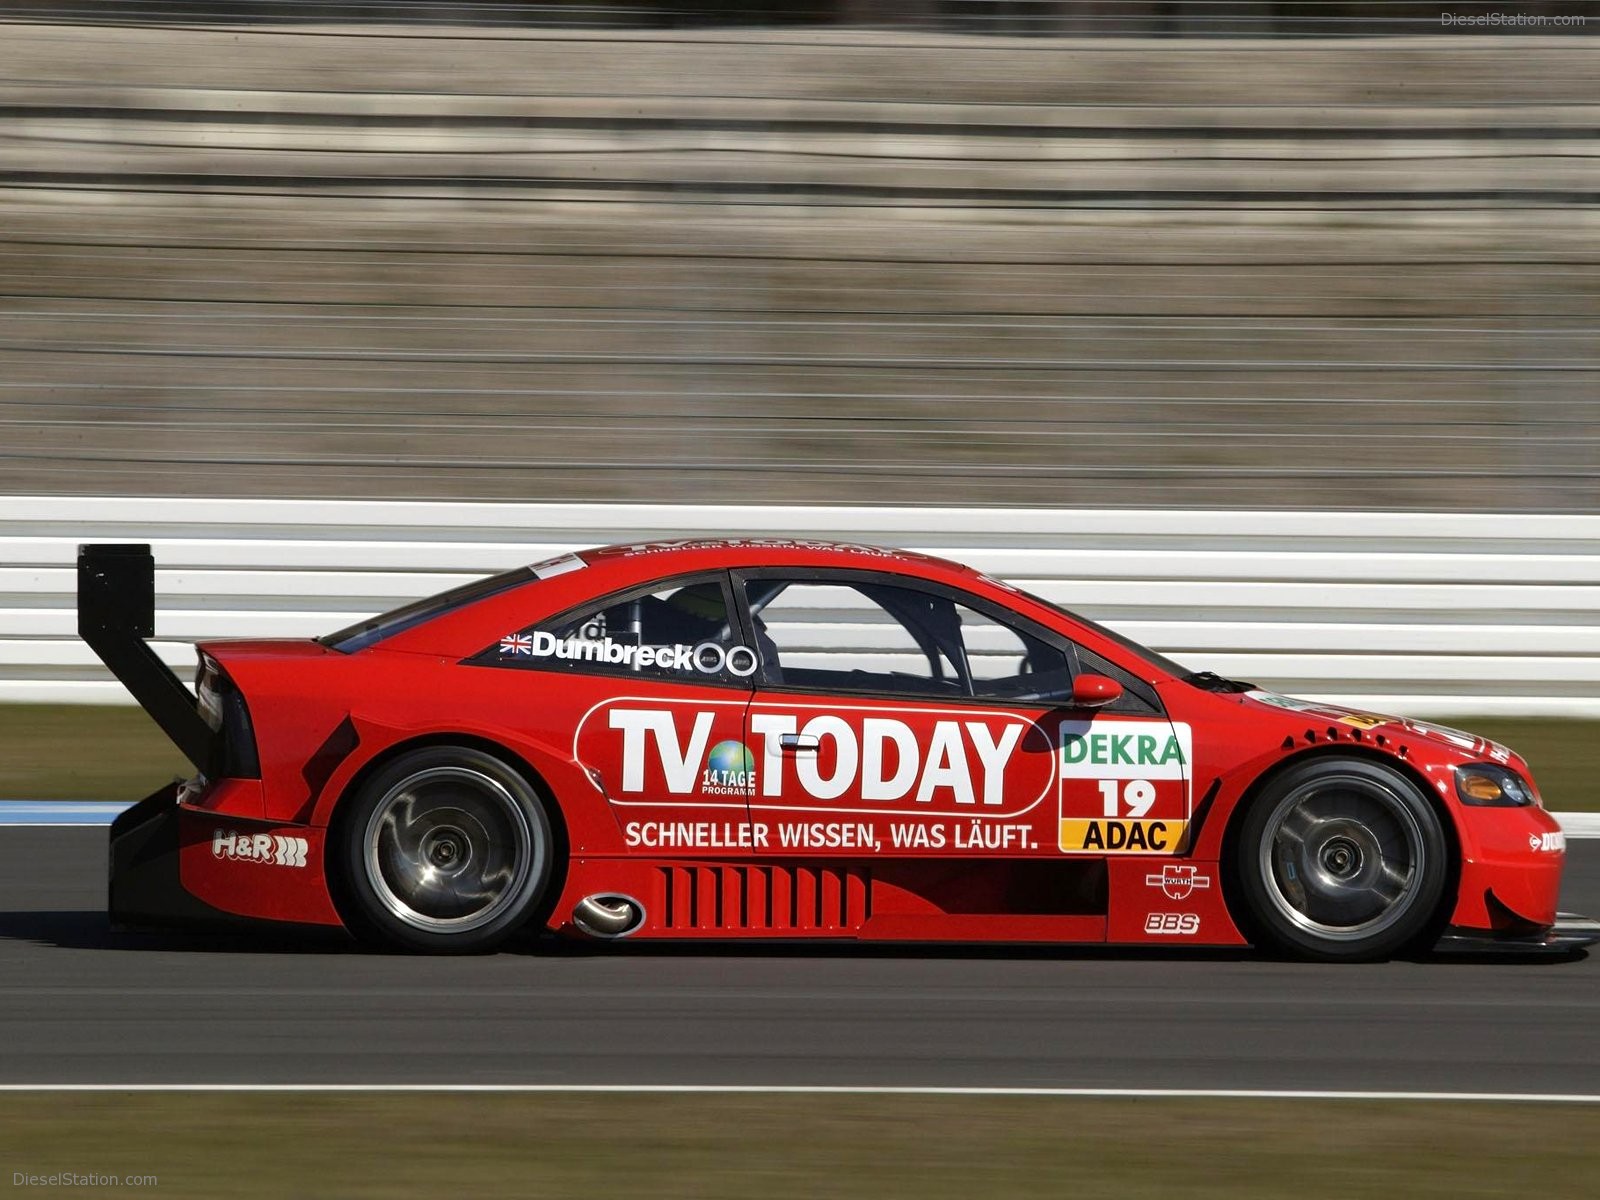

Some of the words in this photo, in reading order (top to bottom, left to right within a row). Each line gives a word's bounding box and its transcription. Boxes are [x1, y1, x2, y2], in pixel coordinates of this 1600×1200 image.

[532, 631, 693, 671] Dumbreck
[608, 708, 716, 795] TV
[751, 713, 1025, 805] TODAY
[1063, 733, 1187, 765] DEKRA
[702, 769, 719, 786] 14
[721, 770, 756, 788] TAGE
[702, 786, 756, 796] PROGRAMM
[1098, 779, 1156, 817] 19
[625, 821, 769, 849] SCHNELLER
[777, 822, 881, 852] WISSEN,
[890, 823, 946, 847] WAS
[954, 819, 1039, 850] LÄUFT.
[1083, 821, 1167, 851] ADAC
[1145, 913, 1200, 934] BBS
